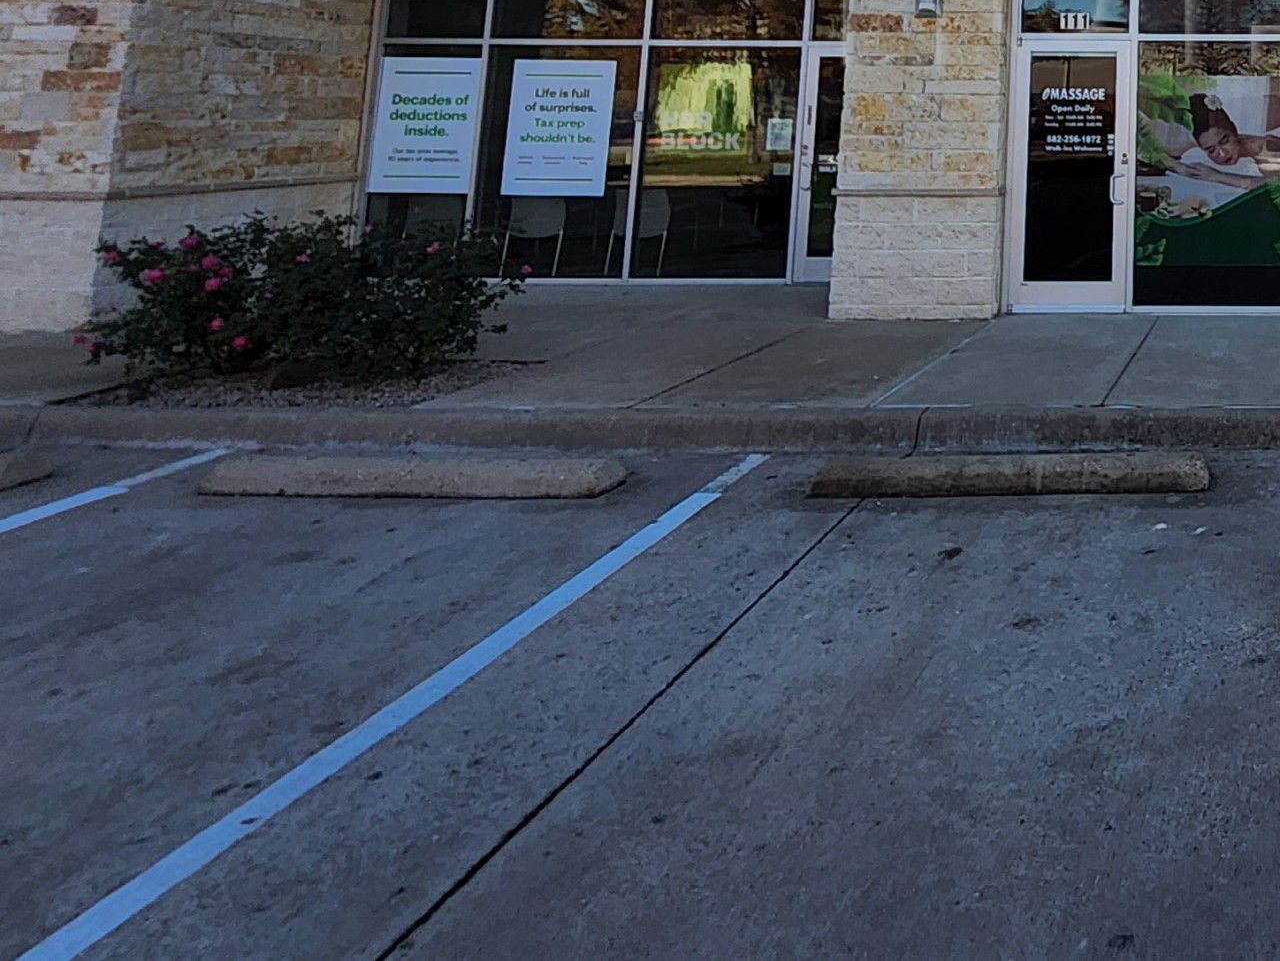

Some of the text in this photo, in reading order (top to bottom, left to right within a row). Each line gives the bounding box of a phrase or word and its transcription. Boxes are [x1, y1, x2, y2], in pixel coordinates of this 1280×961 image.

[1061, 13, 1089, 29] 111
[391, 93, 470, 106] Decades of
[535, 88, 590, 98] Life is full
[1050, 88, 1106, 100] MASSAGE
[524, 102, 597, 114] of surprises.
[1051, 104, 1095, 113] Open Daily
[389, 109, 468, 122] deductions
[534, 117, 585, 130] Tax prep
[404, 124, 450, 137] inside.
[519, 133, 596, 144] shouldn't be.
[660, 132, 740, 151] BLOCK
